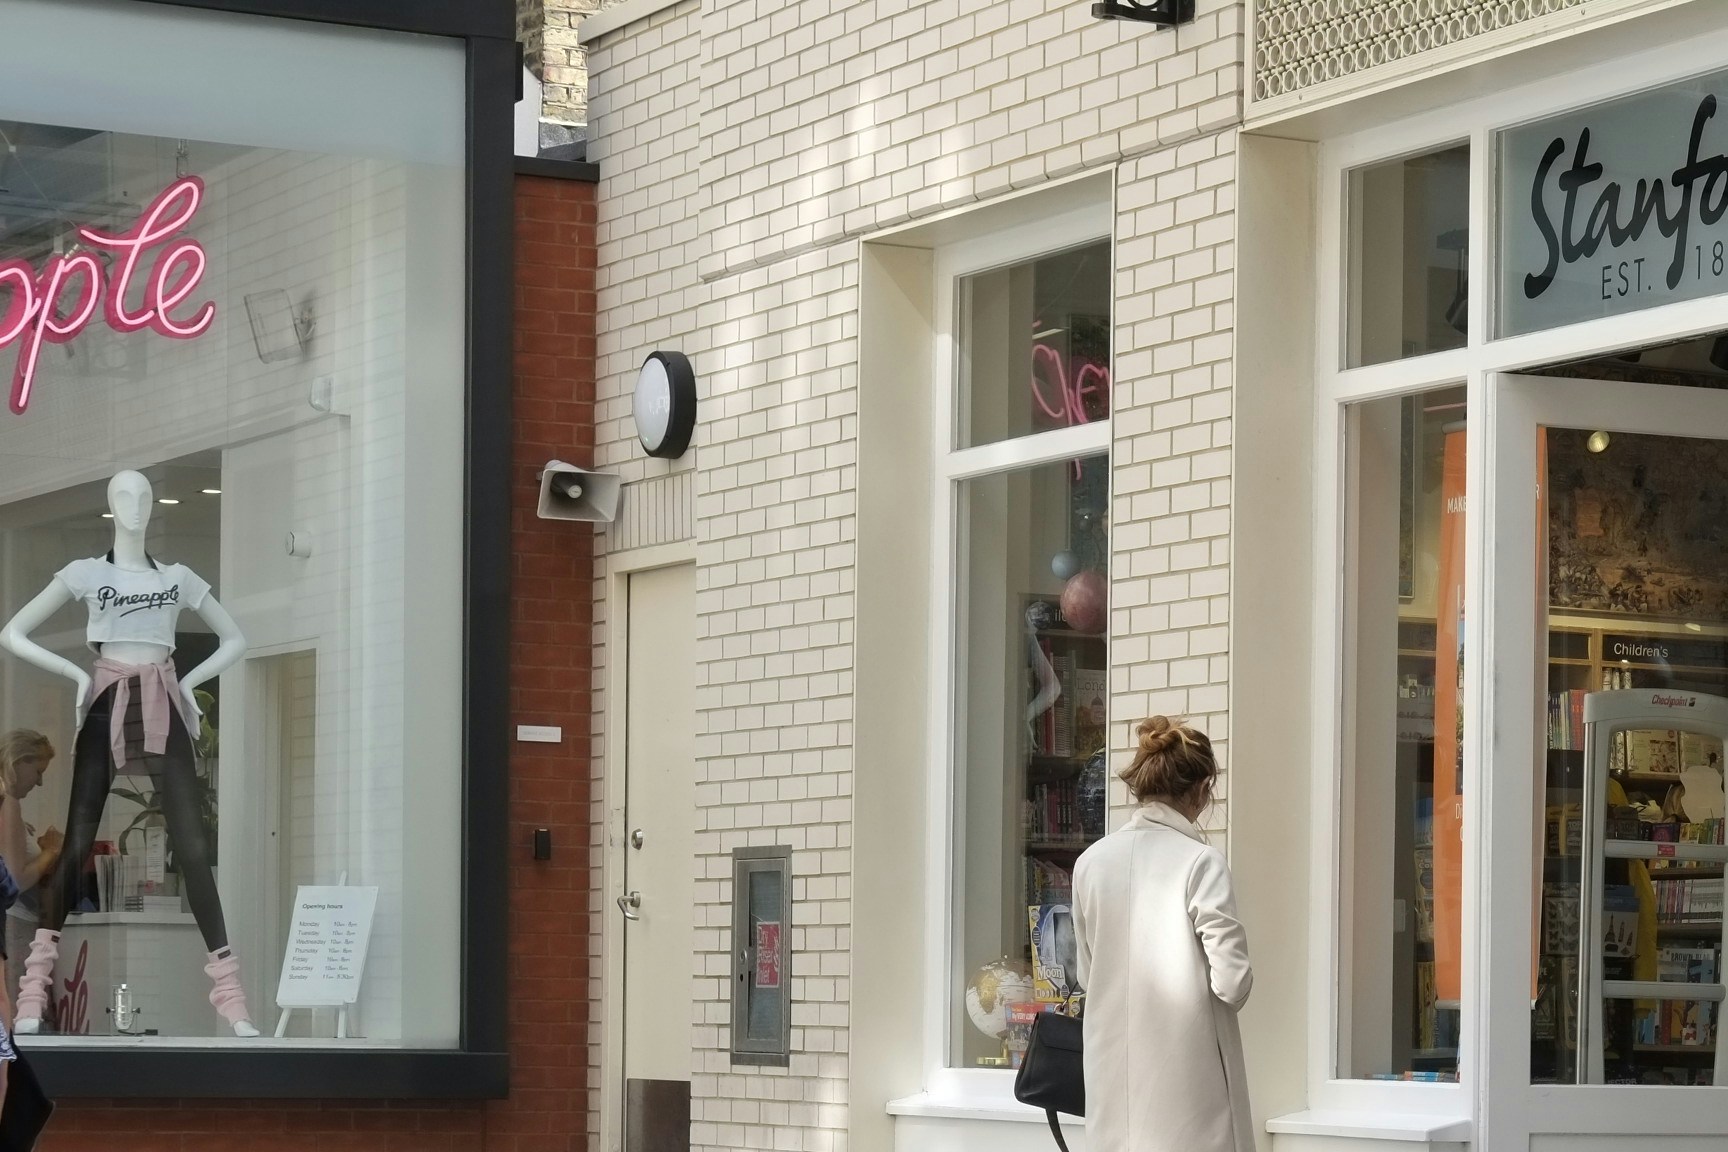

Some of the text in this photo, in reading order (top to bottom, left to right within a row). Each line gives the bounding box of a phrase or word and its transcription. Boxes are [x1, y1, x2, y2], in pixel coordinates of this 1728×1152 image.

[1602, 257, 1652, 300] EST.
[97, 584, 179, 612] Pineapple
[1613, 642, 1669, 658] Children's
[1652, 694, 1688, 708] Checkpoint
[302, 903, 325, 911] Opening
[1037, 965, 1064, 980] Moon
